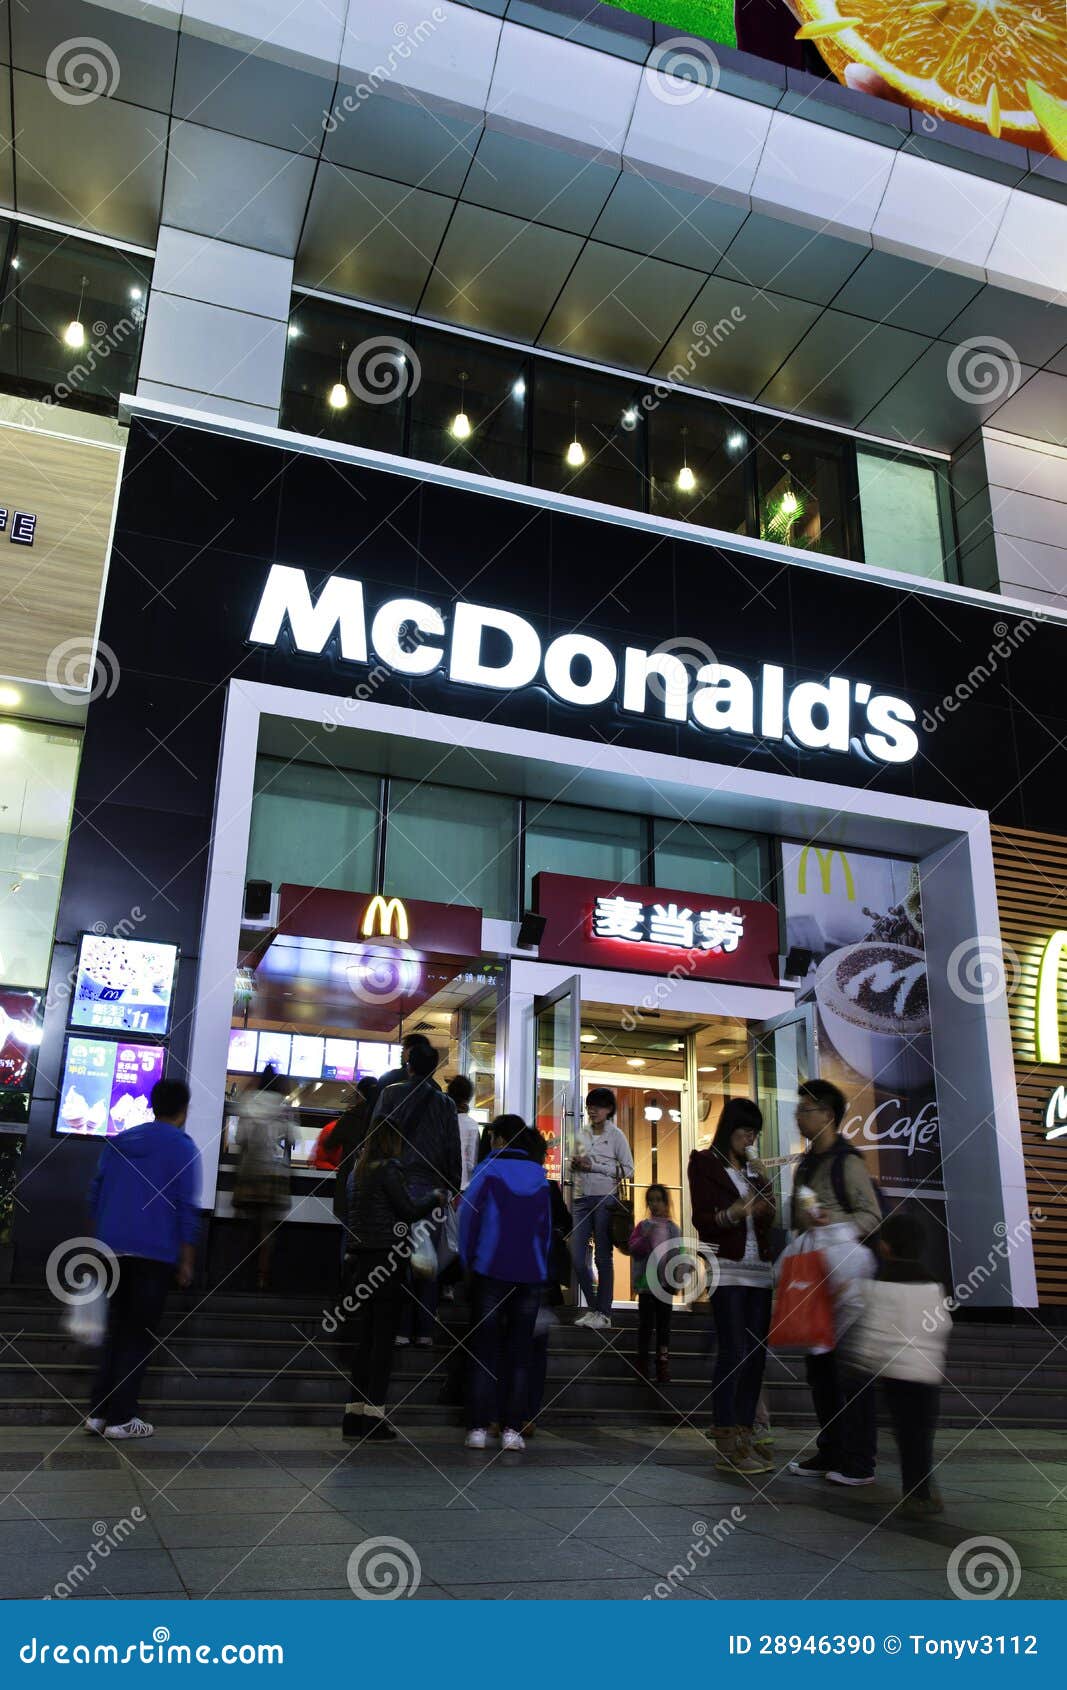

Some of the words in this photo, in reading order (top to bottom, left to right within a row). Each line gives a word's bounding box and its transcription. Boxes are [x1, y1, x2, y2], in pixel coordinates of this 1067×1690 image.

[248, 563, 920, 763] McDonald's
[594, 896, 744, 953] 麦当劳
[837, 1099, 940, 1156] cCafé
